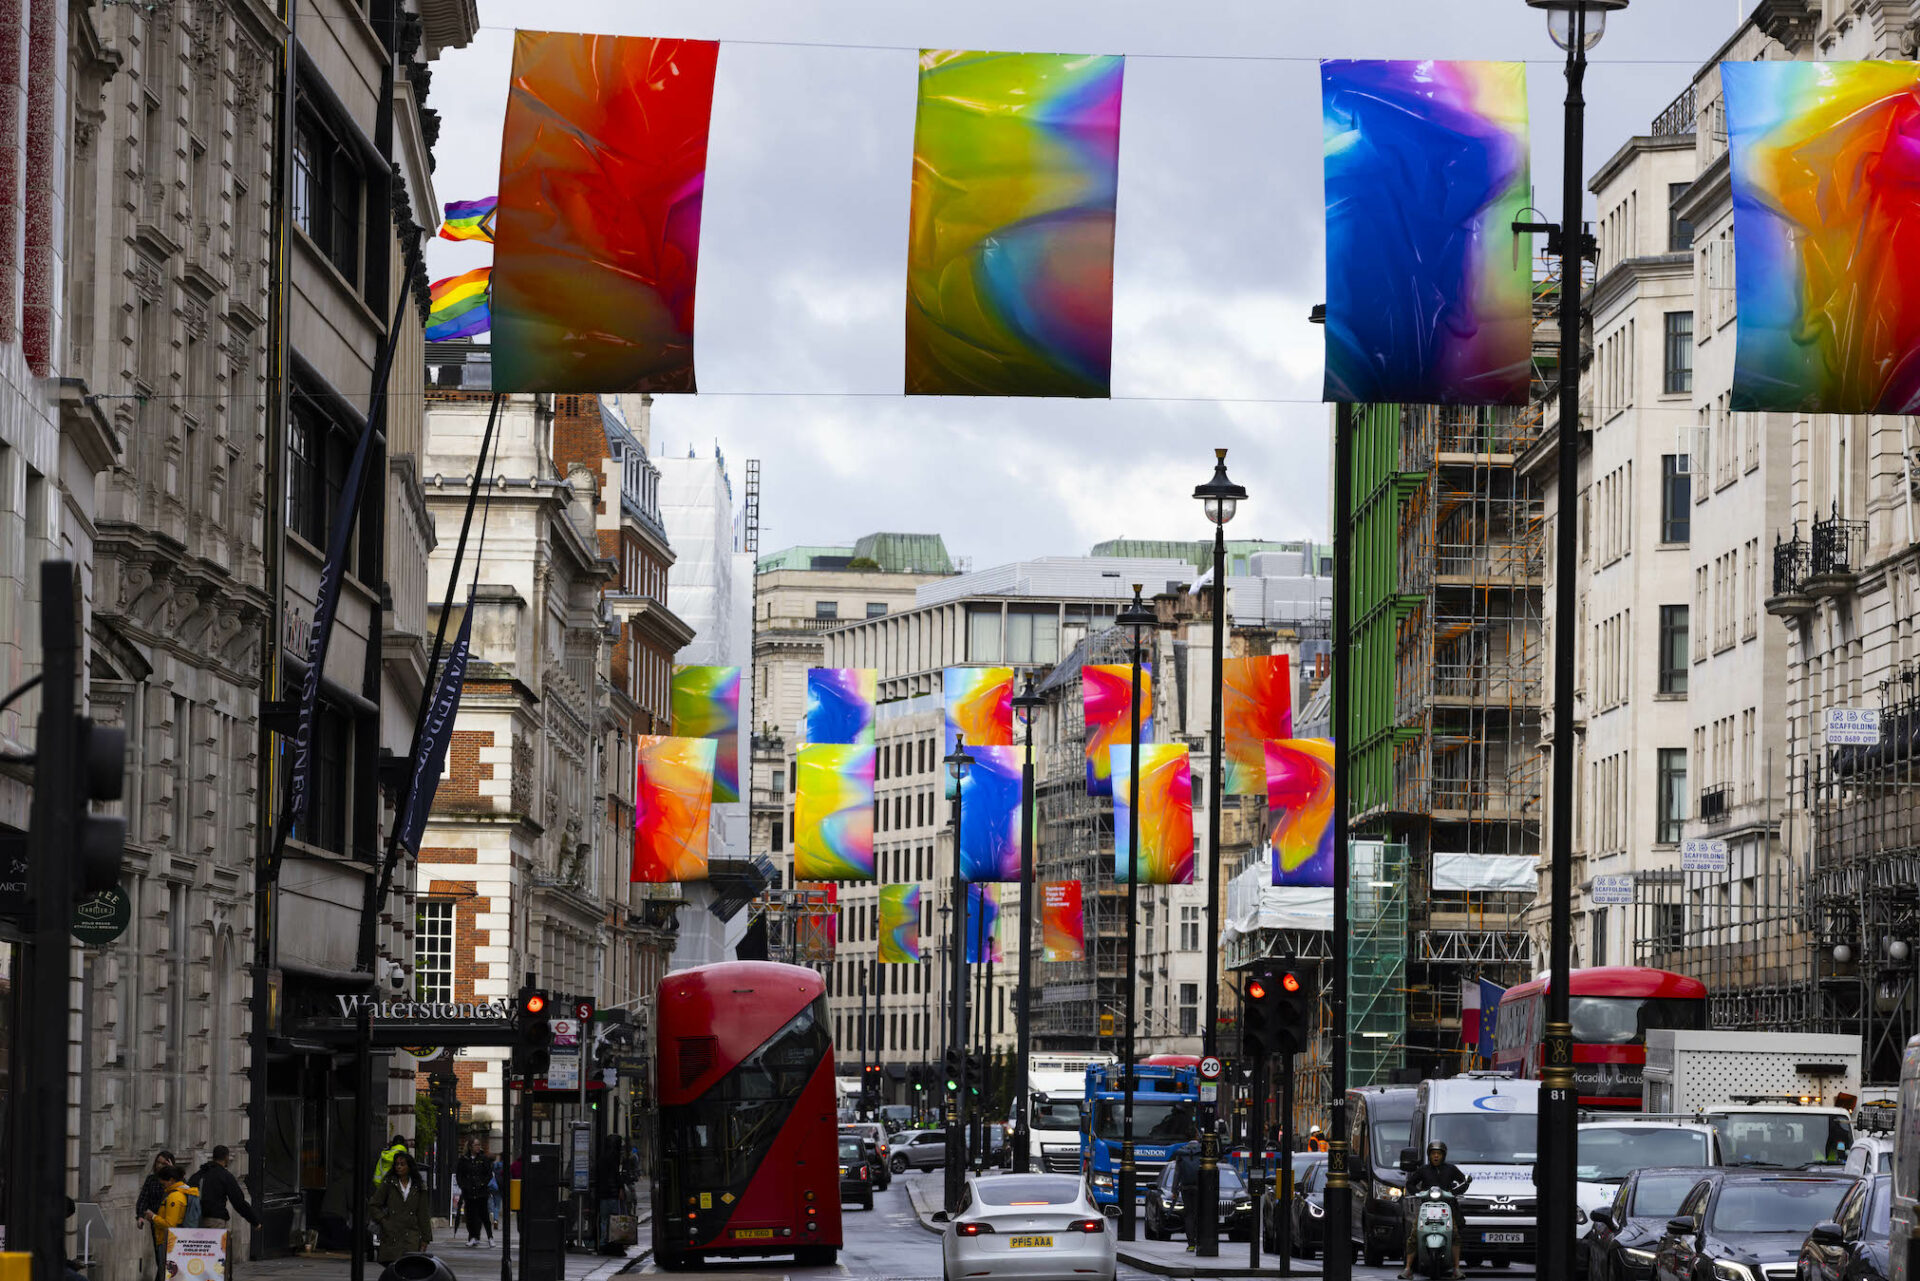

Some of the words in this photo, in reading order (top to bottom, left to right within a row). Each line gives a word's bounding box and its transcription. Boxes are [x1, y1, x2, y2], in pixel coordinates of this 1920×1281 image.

[1829, 722, 1877, 730] SCAFFOLDING
[1683, 852, 1725, 860] SCAFFOLDING
[336, 994, 502, 1019] Waterstones
[580, 1005, 588, 1019] S
[1203, 1062, 1219, 1071] 20
[1572, 1072, 1612, 1085] iccadilly
[1615, 1071, 1644, 1084] Circus
[1551, 1090, 1566, 1100] 81
[1333, 1098, 1344, 1106] 80
[1012, 1237, 1032, 1246] PP15
[1034, 1237, 1051, 1246] AAA
[1488, 1233, 1503, 1241] P20
[1505, 1233, 1520, 1241] CVS
